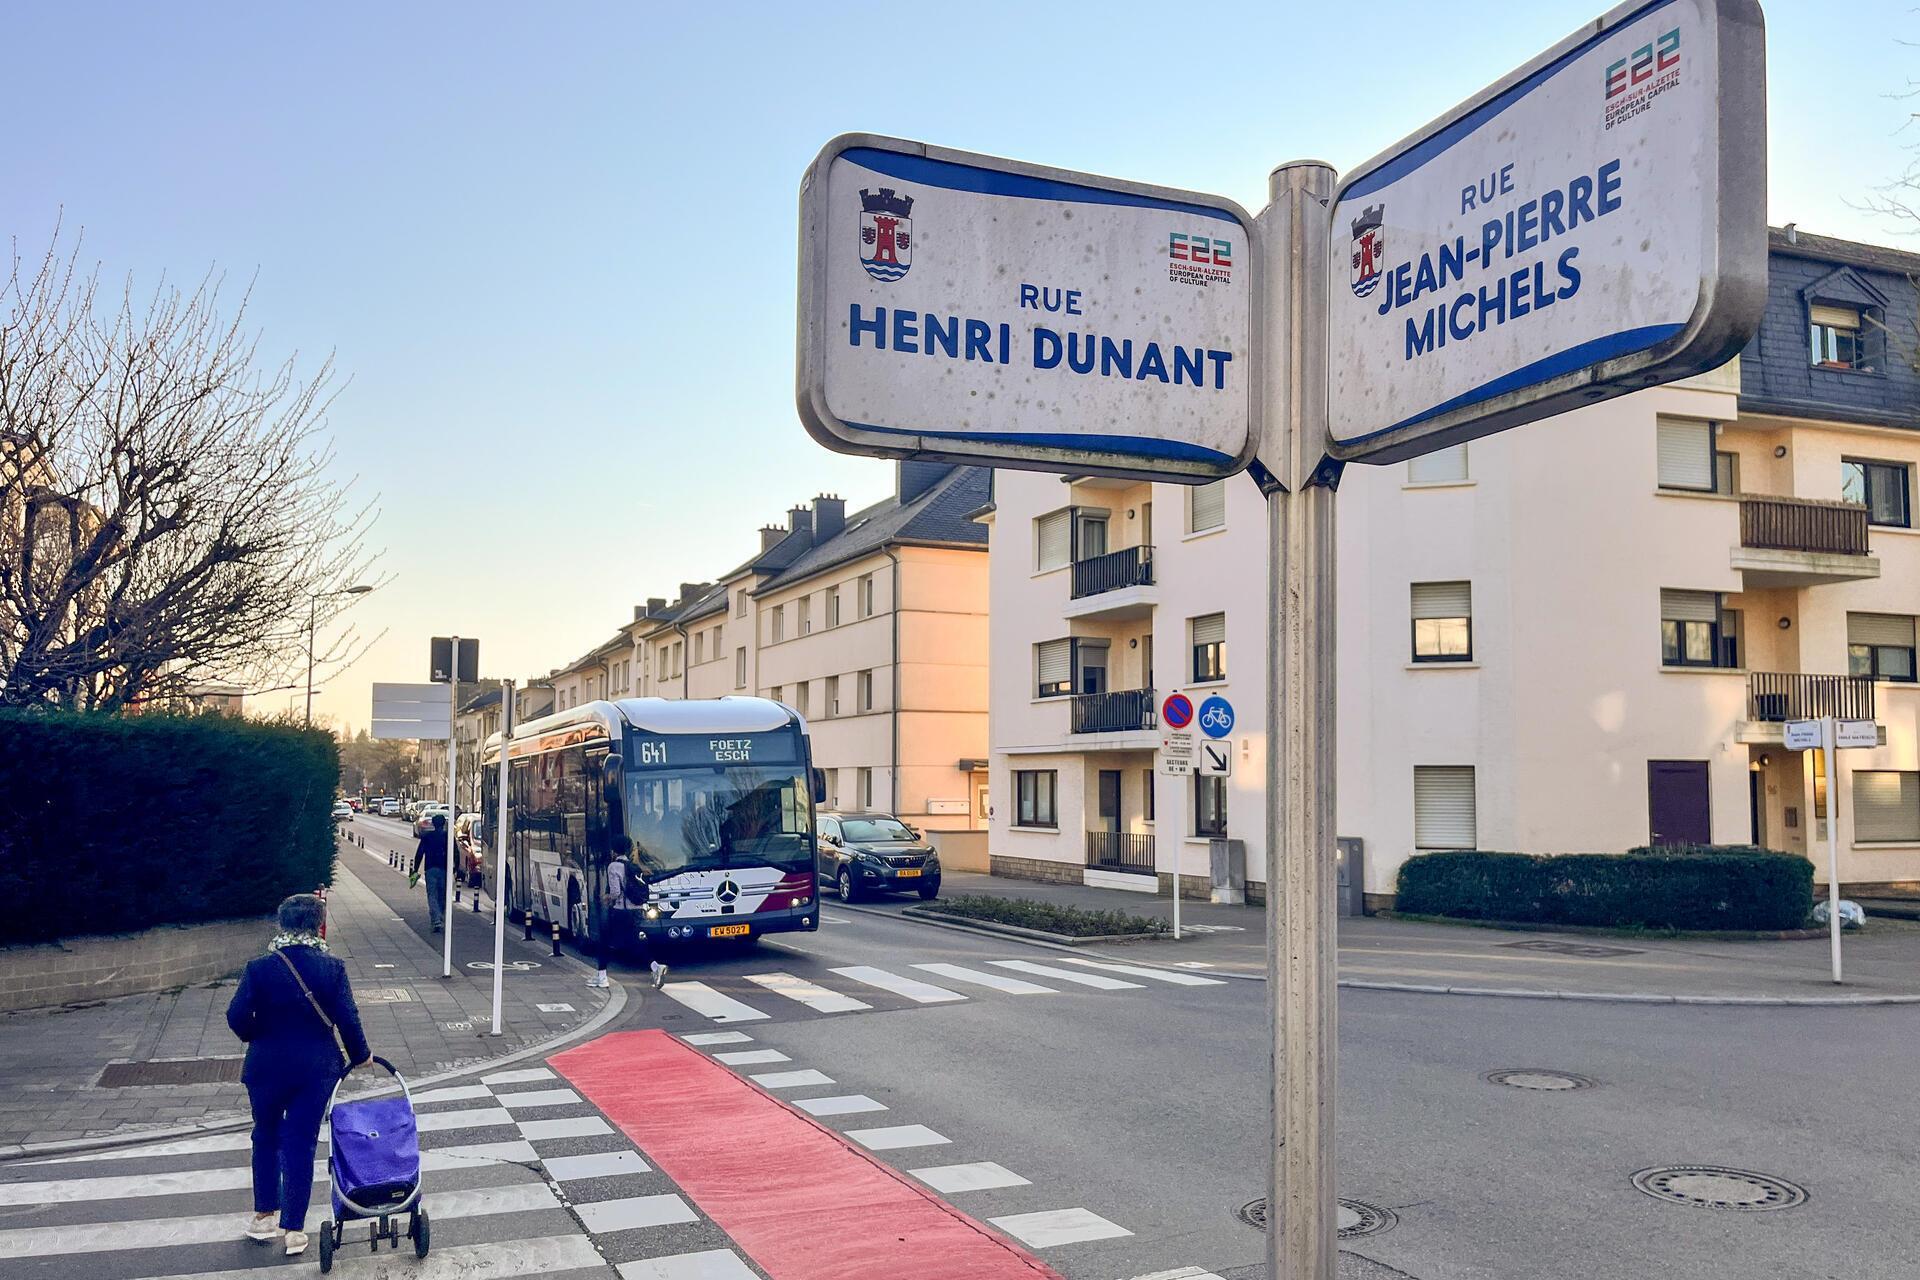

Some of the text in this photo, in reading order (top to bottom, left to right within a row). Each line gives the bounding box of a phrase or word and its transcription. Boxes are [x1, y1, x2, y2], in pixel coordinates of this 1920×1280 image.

[1606, 27, 1680, 101] E22
[1606, 68, 1680, 114] ESCH-SUR-ALZETTE
[1606, 78, 1680, 122] EUROPEAN CAPITAL
[1605, 101, 1651, 131] OF CULTURE
[1461, 162, 1515, 215] RUE
[1170, 232, 1231, 267] E22
[1377, 158, 1622, 315] JEAN-PIERRE
[1169, 263, 1231, 277] ESCH-SUR-ALZETTE
[1169, 269, 1231, 284] EUROPEAN CAPITAL
[1179, 277, 1208, 287] CULTURE
[1020, 283, 1082, 316] RUE
[1405, 246, 1582, 360] MICHELS
[849, 303, 1233, 390] HENRI DUNANT
[641, 741, 667, 764] 641
[709, 739, 752, 751] FOETZ
[715, 750, 750, 762] ESCH
